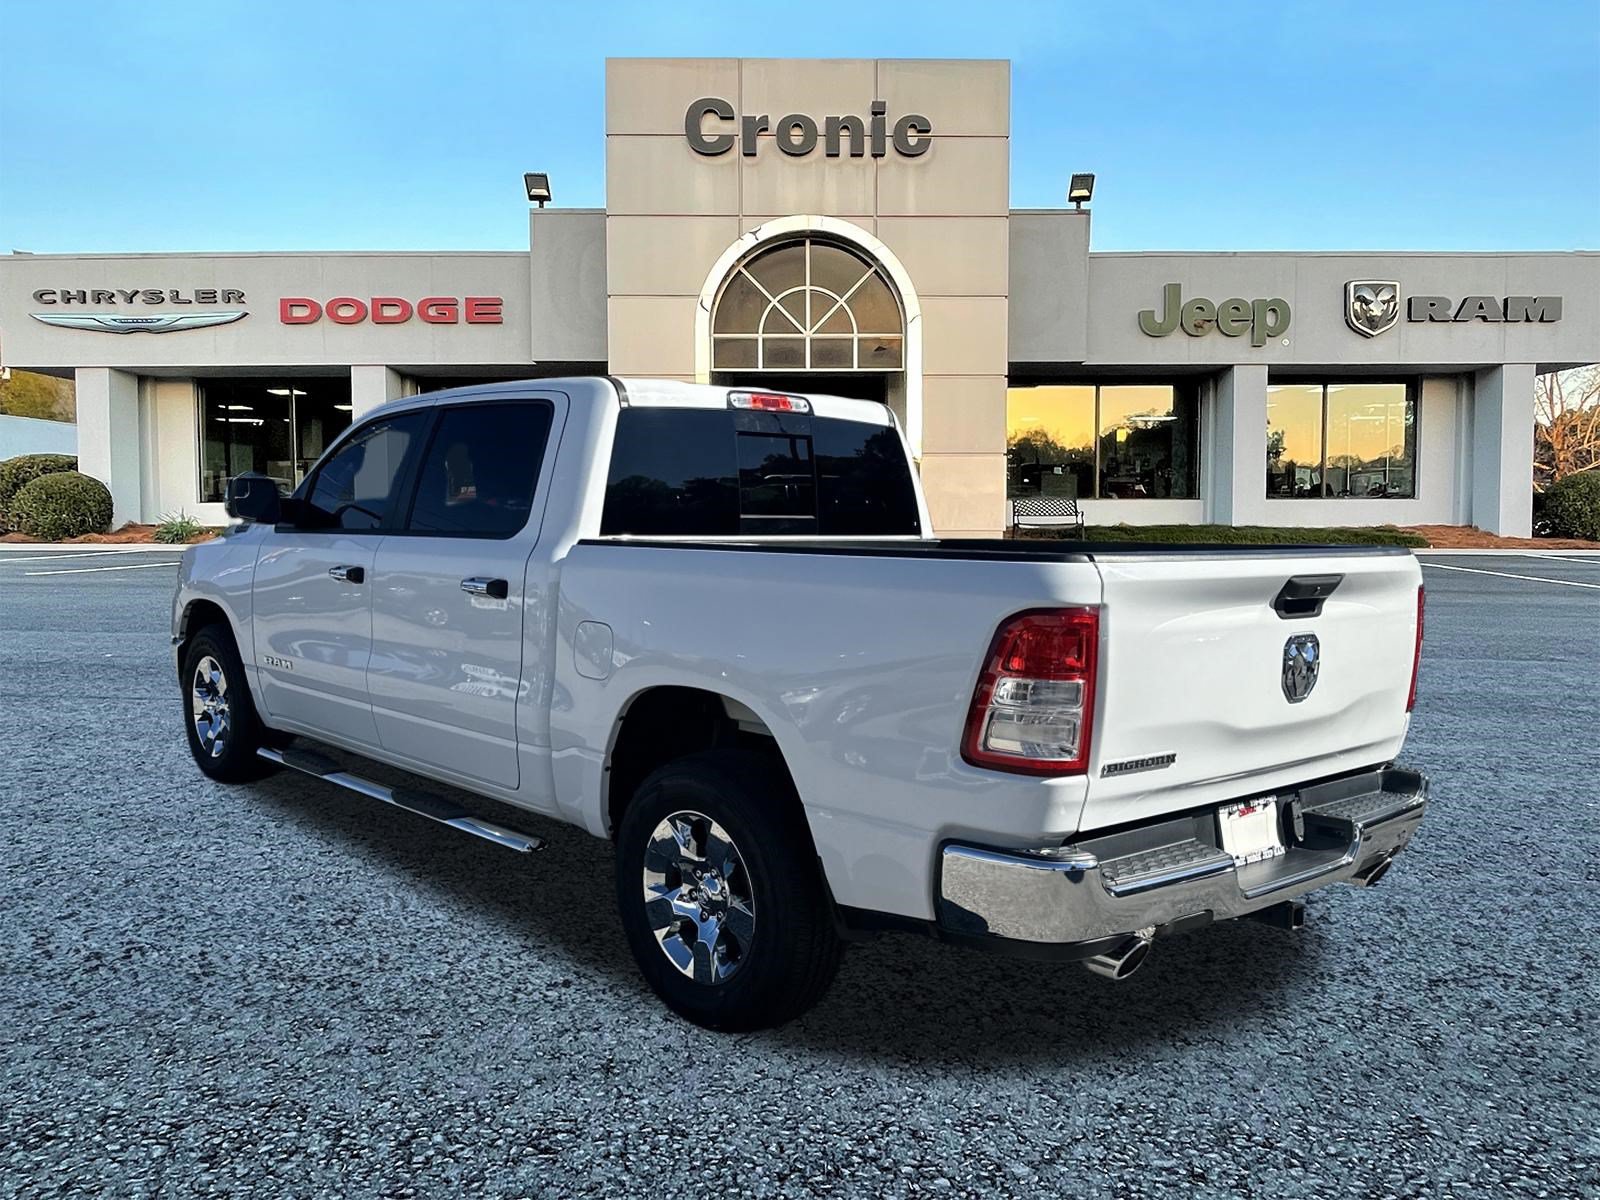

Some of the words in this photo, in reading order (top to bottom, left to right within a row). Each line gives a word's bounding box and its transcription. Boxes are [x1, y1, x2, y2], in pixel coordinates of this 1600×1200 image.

[685, 97, 932, 158] Cronic
[32, 289, 246, 305] CHRYSLER
[1407, 296, 1562, 323] RAM
[279, 297, 503, 325] DODGE
[1138, 283, 1291, 347] Jeep
[263, 655, 293, 670] RAM
[1103, 753, 1177, 776] BIGHORN
